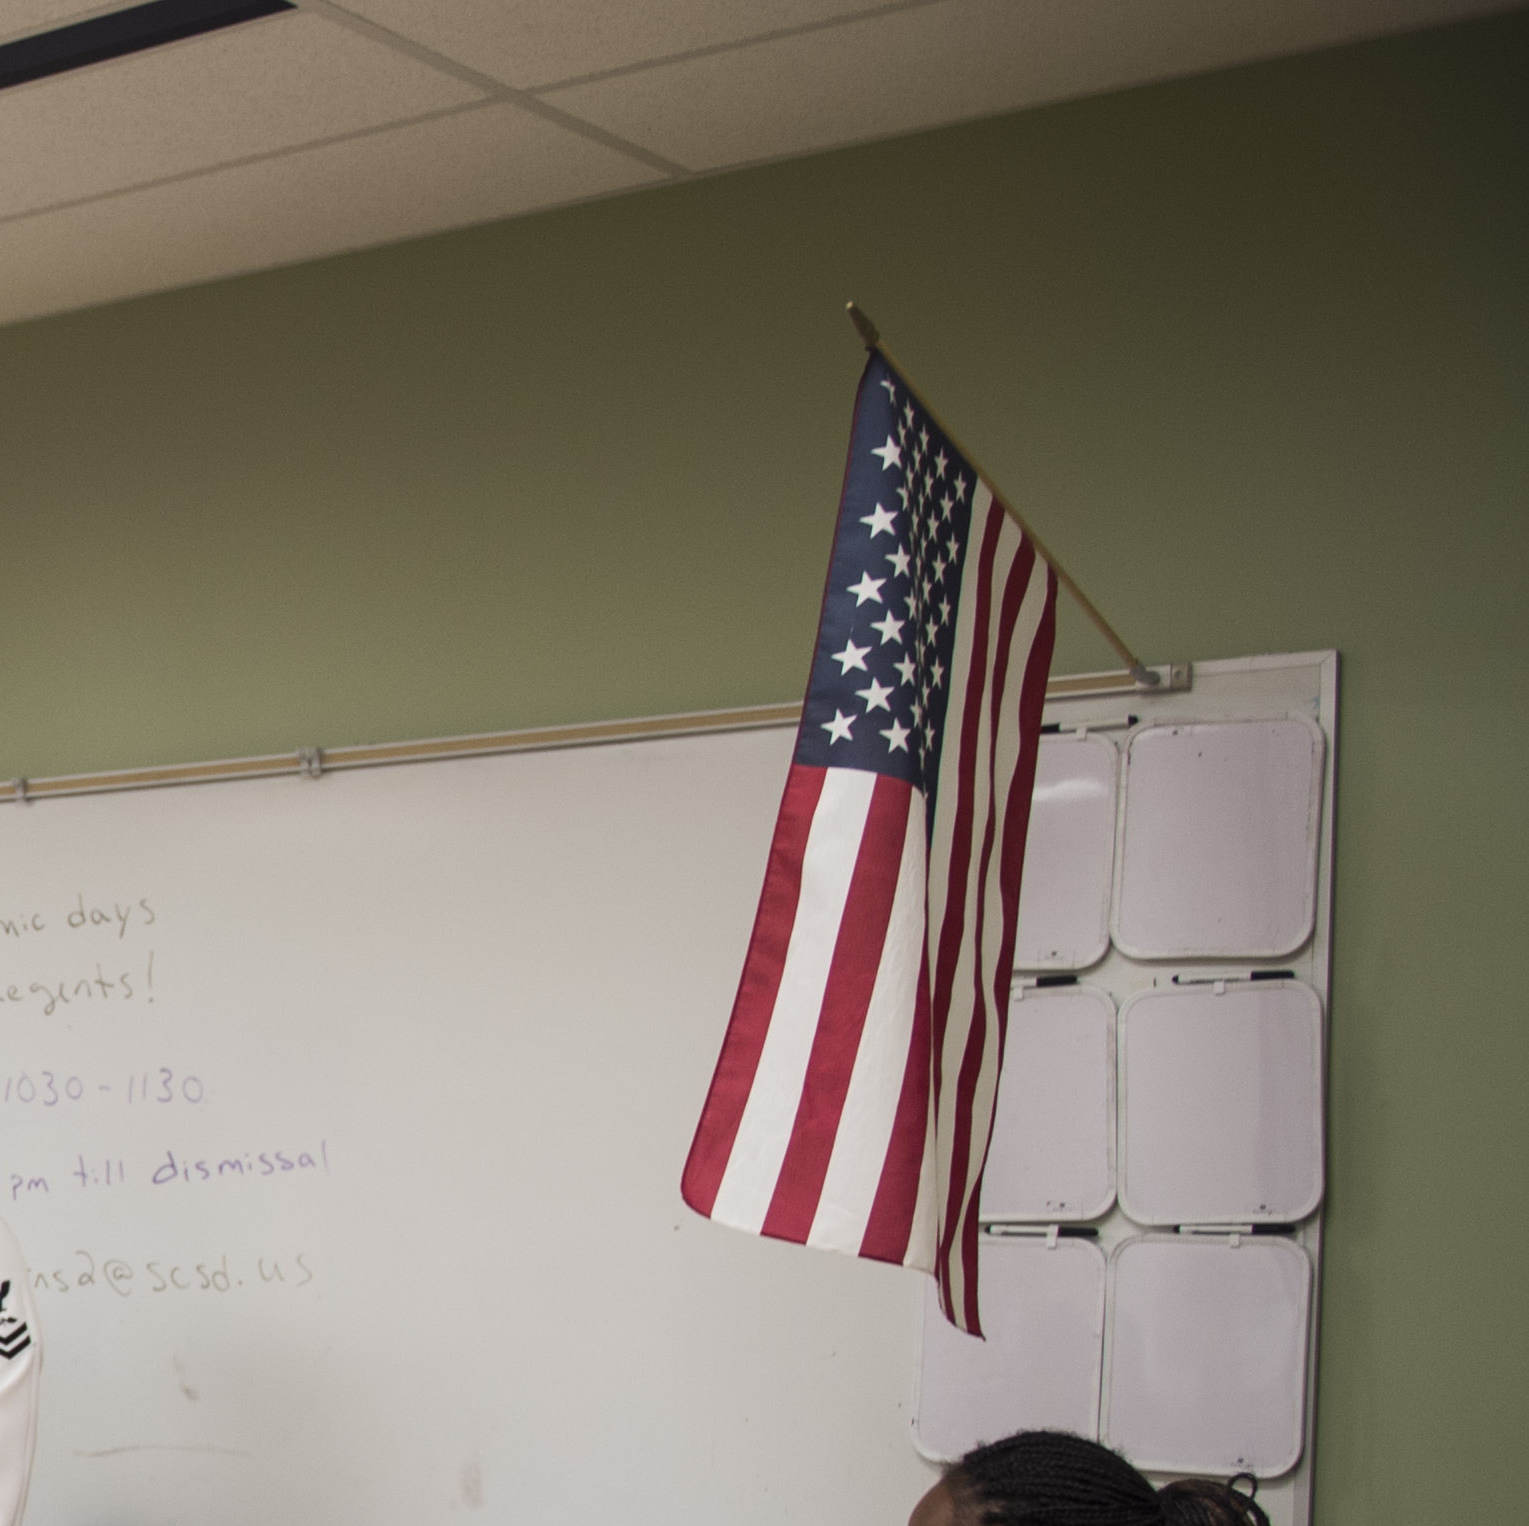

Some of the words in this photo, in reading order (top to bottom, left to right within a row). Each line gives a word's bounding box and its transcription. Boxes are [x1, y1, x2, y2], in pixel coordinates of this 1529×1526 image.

[67, 893, 156, 939] days
[73, 1154, 124, 1188] till
[151, 1139, 330, 1184] dismissal
